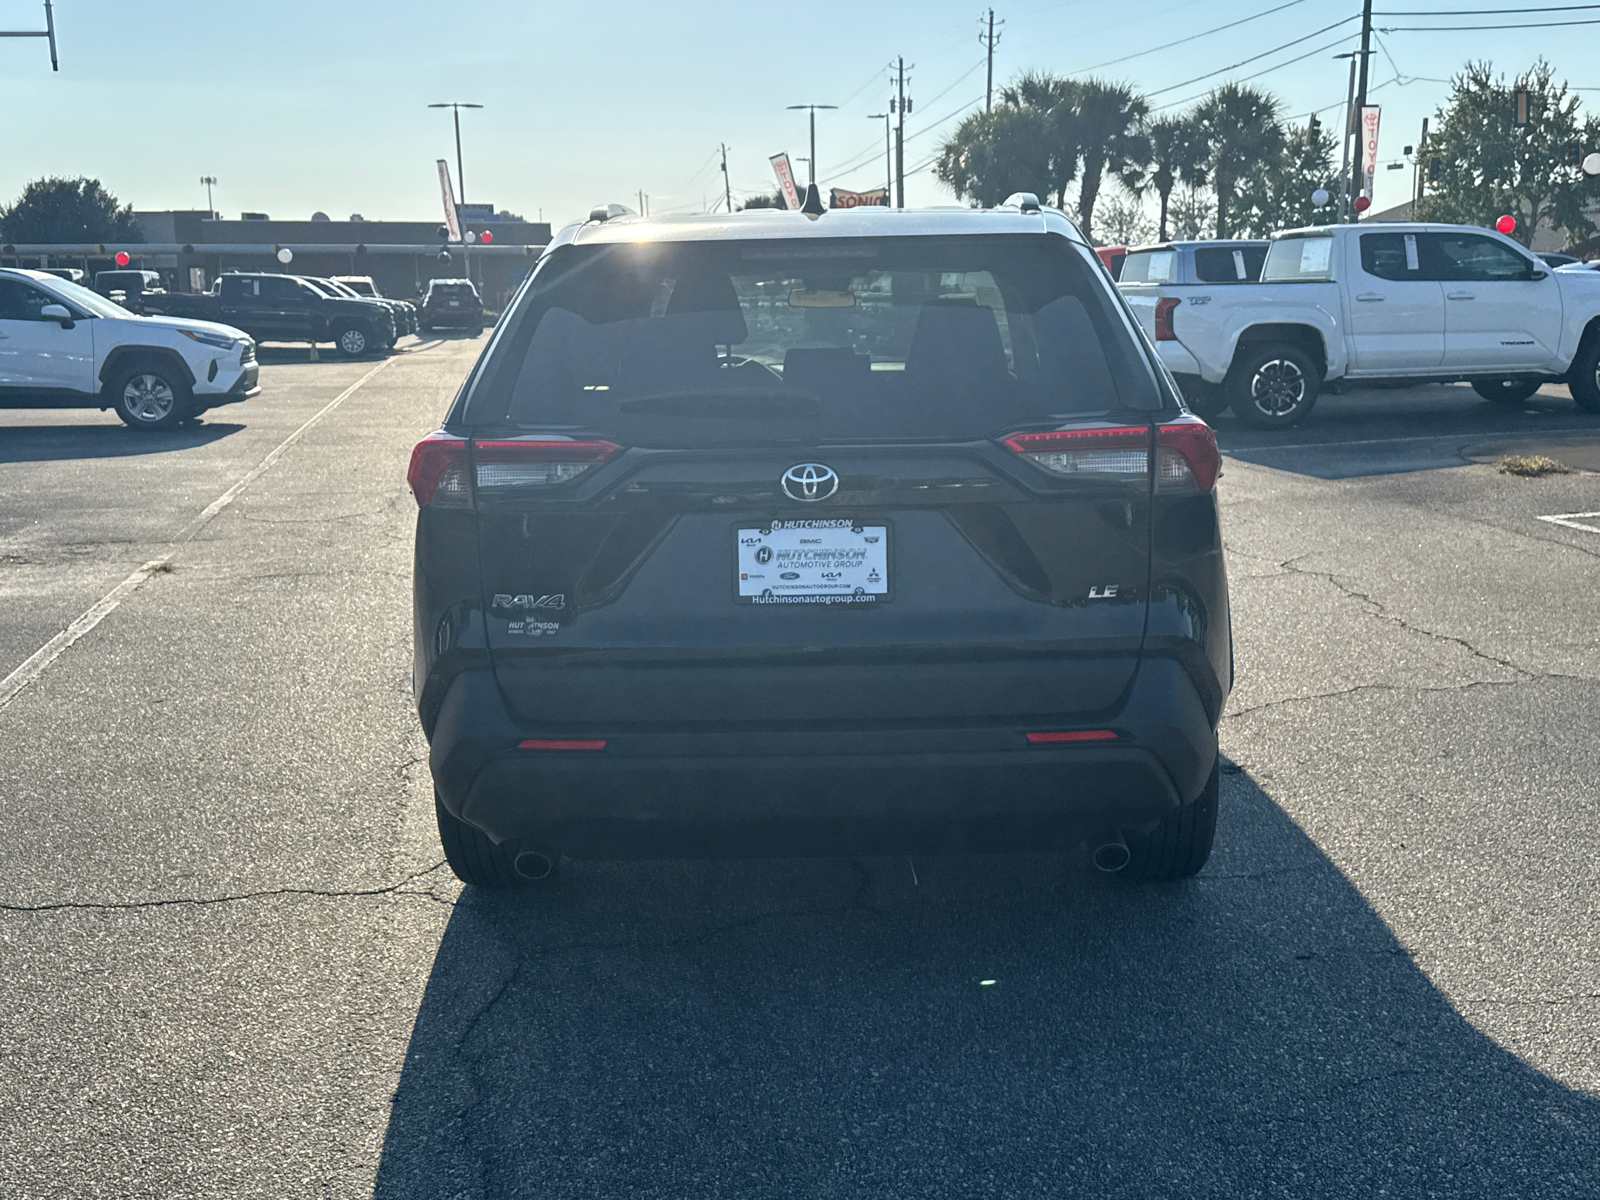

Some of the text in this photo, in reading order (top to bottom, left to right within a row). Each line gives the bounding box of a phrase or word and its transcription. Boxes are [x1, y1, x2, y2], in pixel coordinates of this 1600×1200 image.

[836, 195, 881, 208] SONIC
[783, 519, 853, 529] HUTCHINSON
[775, 548, 867, 561] HUTCHINSON
[777, 560, 863, 569] AUTOMOTIVE GROUP
[1088, 584, 1119, 598] LE
[491, 593, 566, 609] RAV4
[752, 594, 876, 604] Hutchinsonautogroup.com
